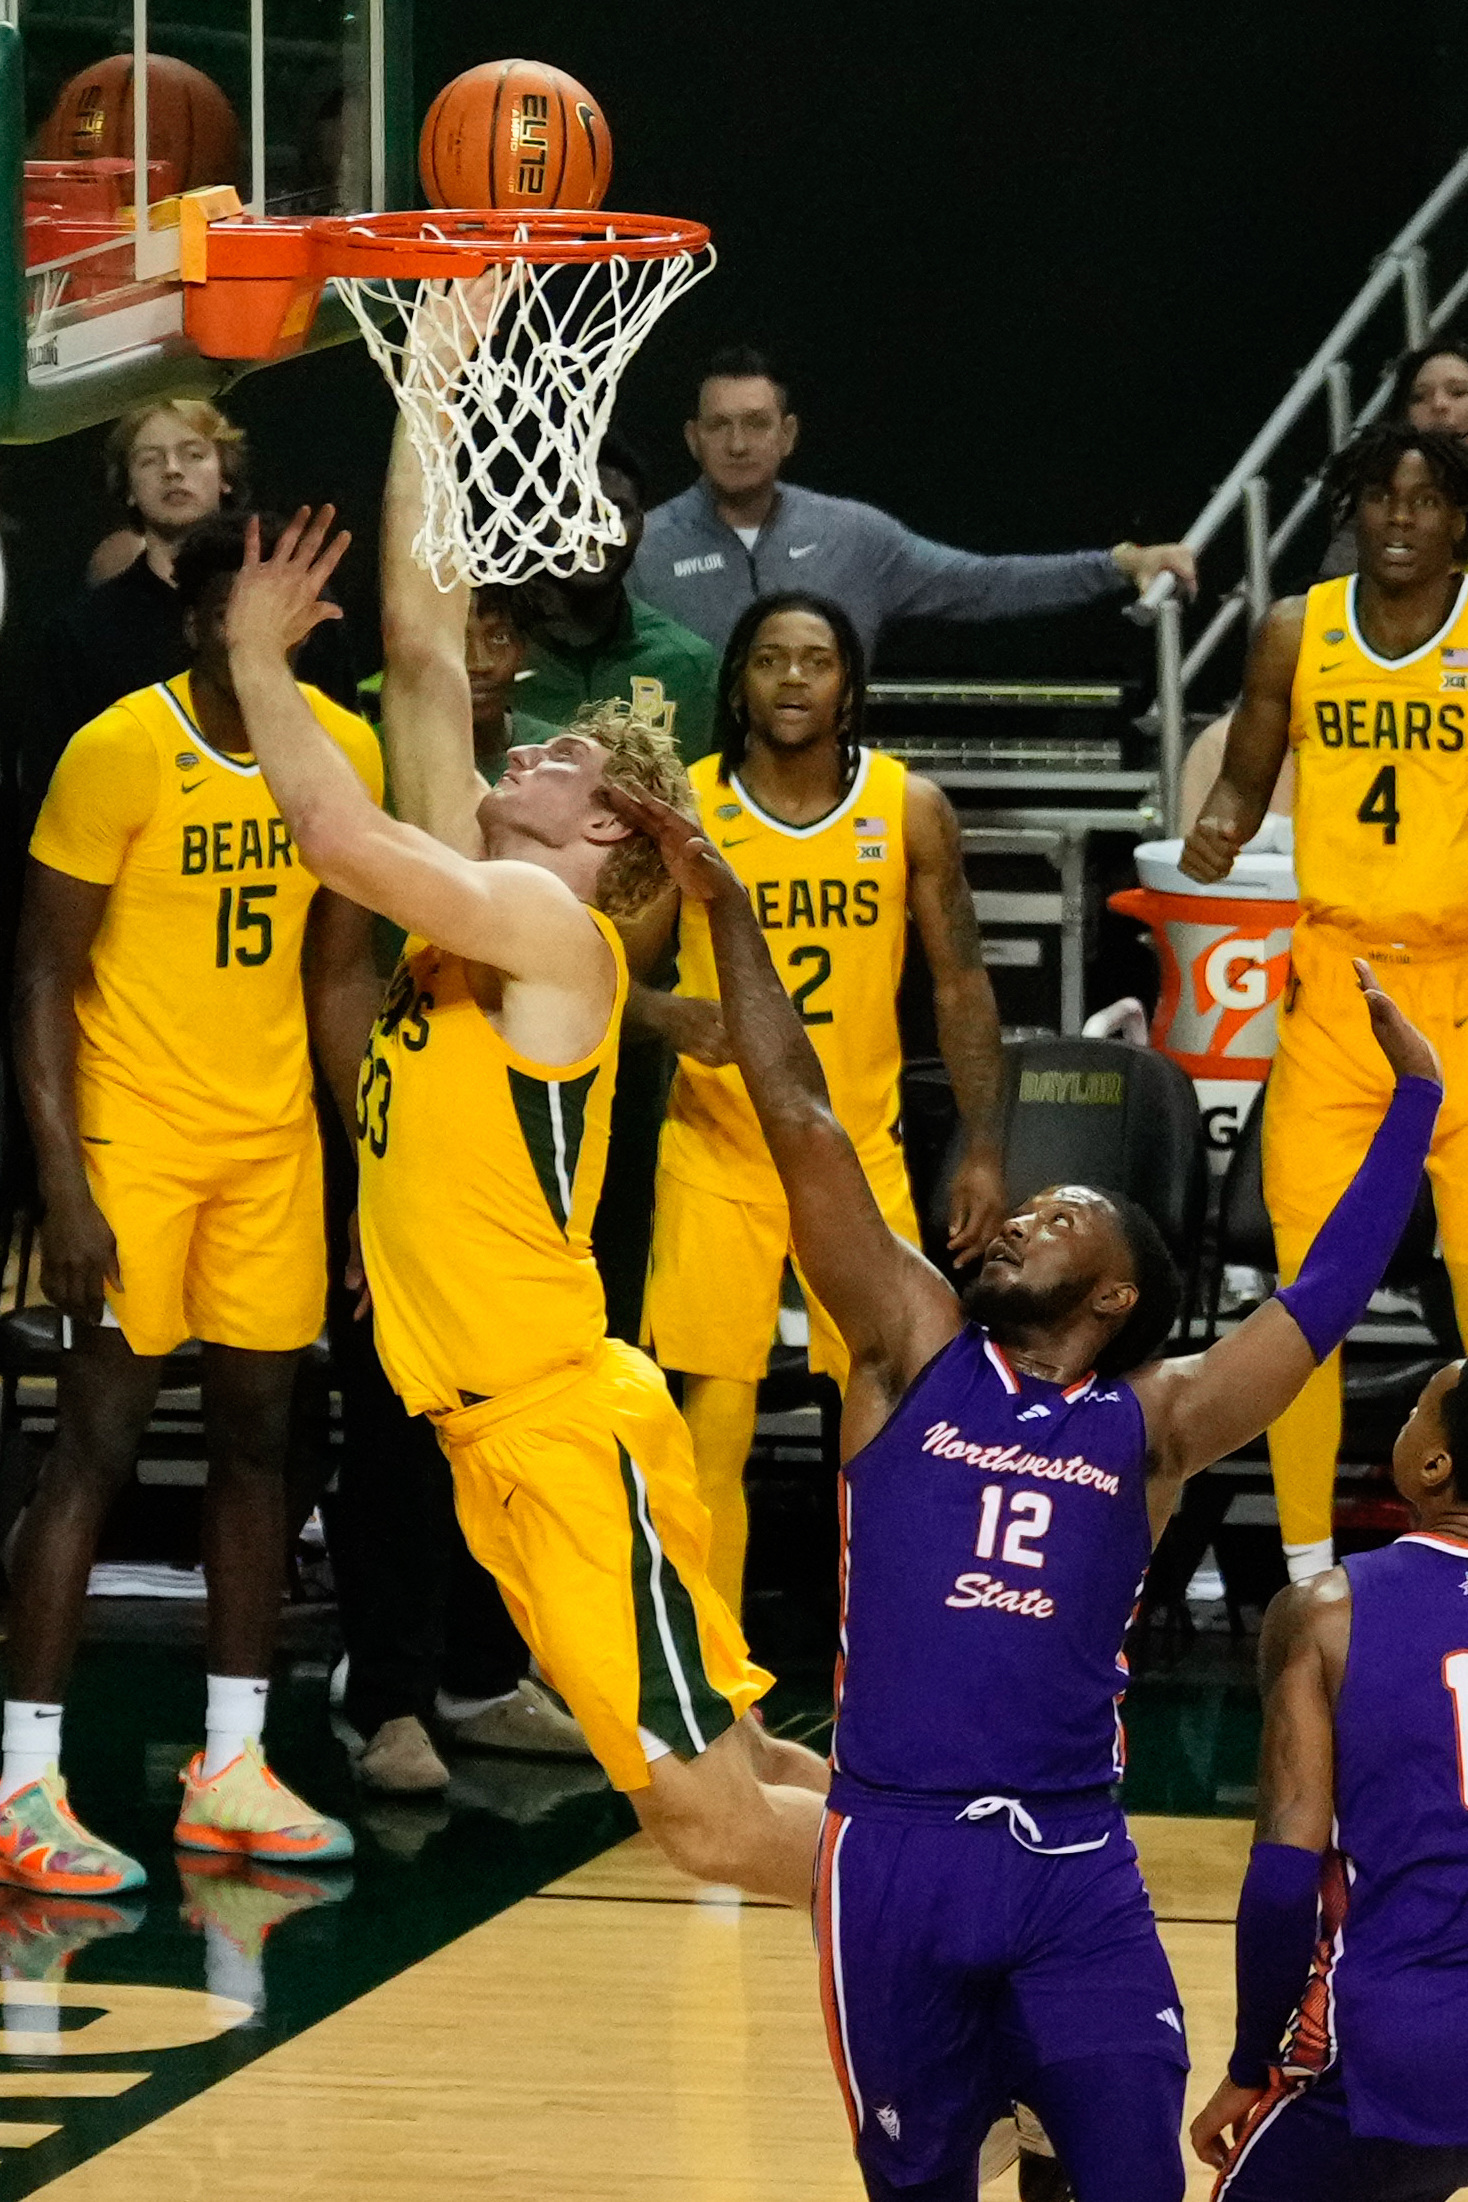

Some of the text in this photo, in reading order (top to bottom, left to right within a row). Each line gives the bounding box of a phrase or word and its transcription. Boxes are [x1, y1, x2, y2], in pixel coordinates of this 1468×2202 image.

[515, 93, 548, 196] ELITE
[1314, 699, 1465, 752] BEARS
[1356, 765, 1400, 845] 4
[181, 817, 293, 876] BEAR
[216, 884, 278, 968] 15
[756, 878, 880, 929] EARS
[788, 945, 834, 1026] 2
[1204, 939, 1268, 1010] G
[1019, 1071, 1121, 1104] BAYLOR
[1201, 1106, 1240, 1148] G
[921, 1420, 1120, 1497] Northwestern
[975, 1484, 1053, 1569] 12
[944, 1572, 1056, 1620] State
